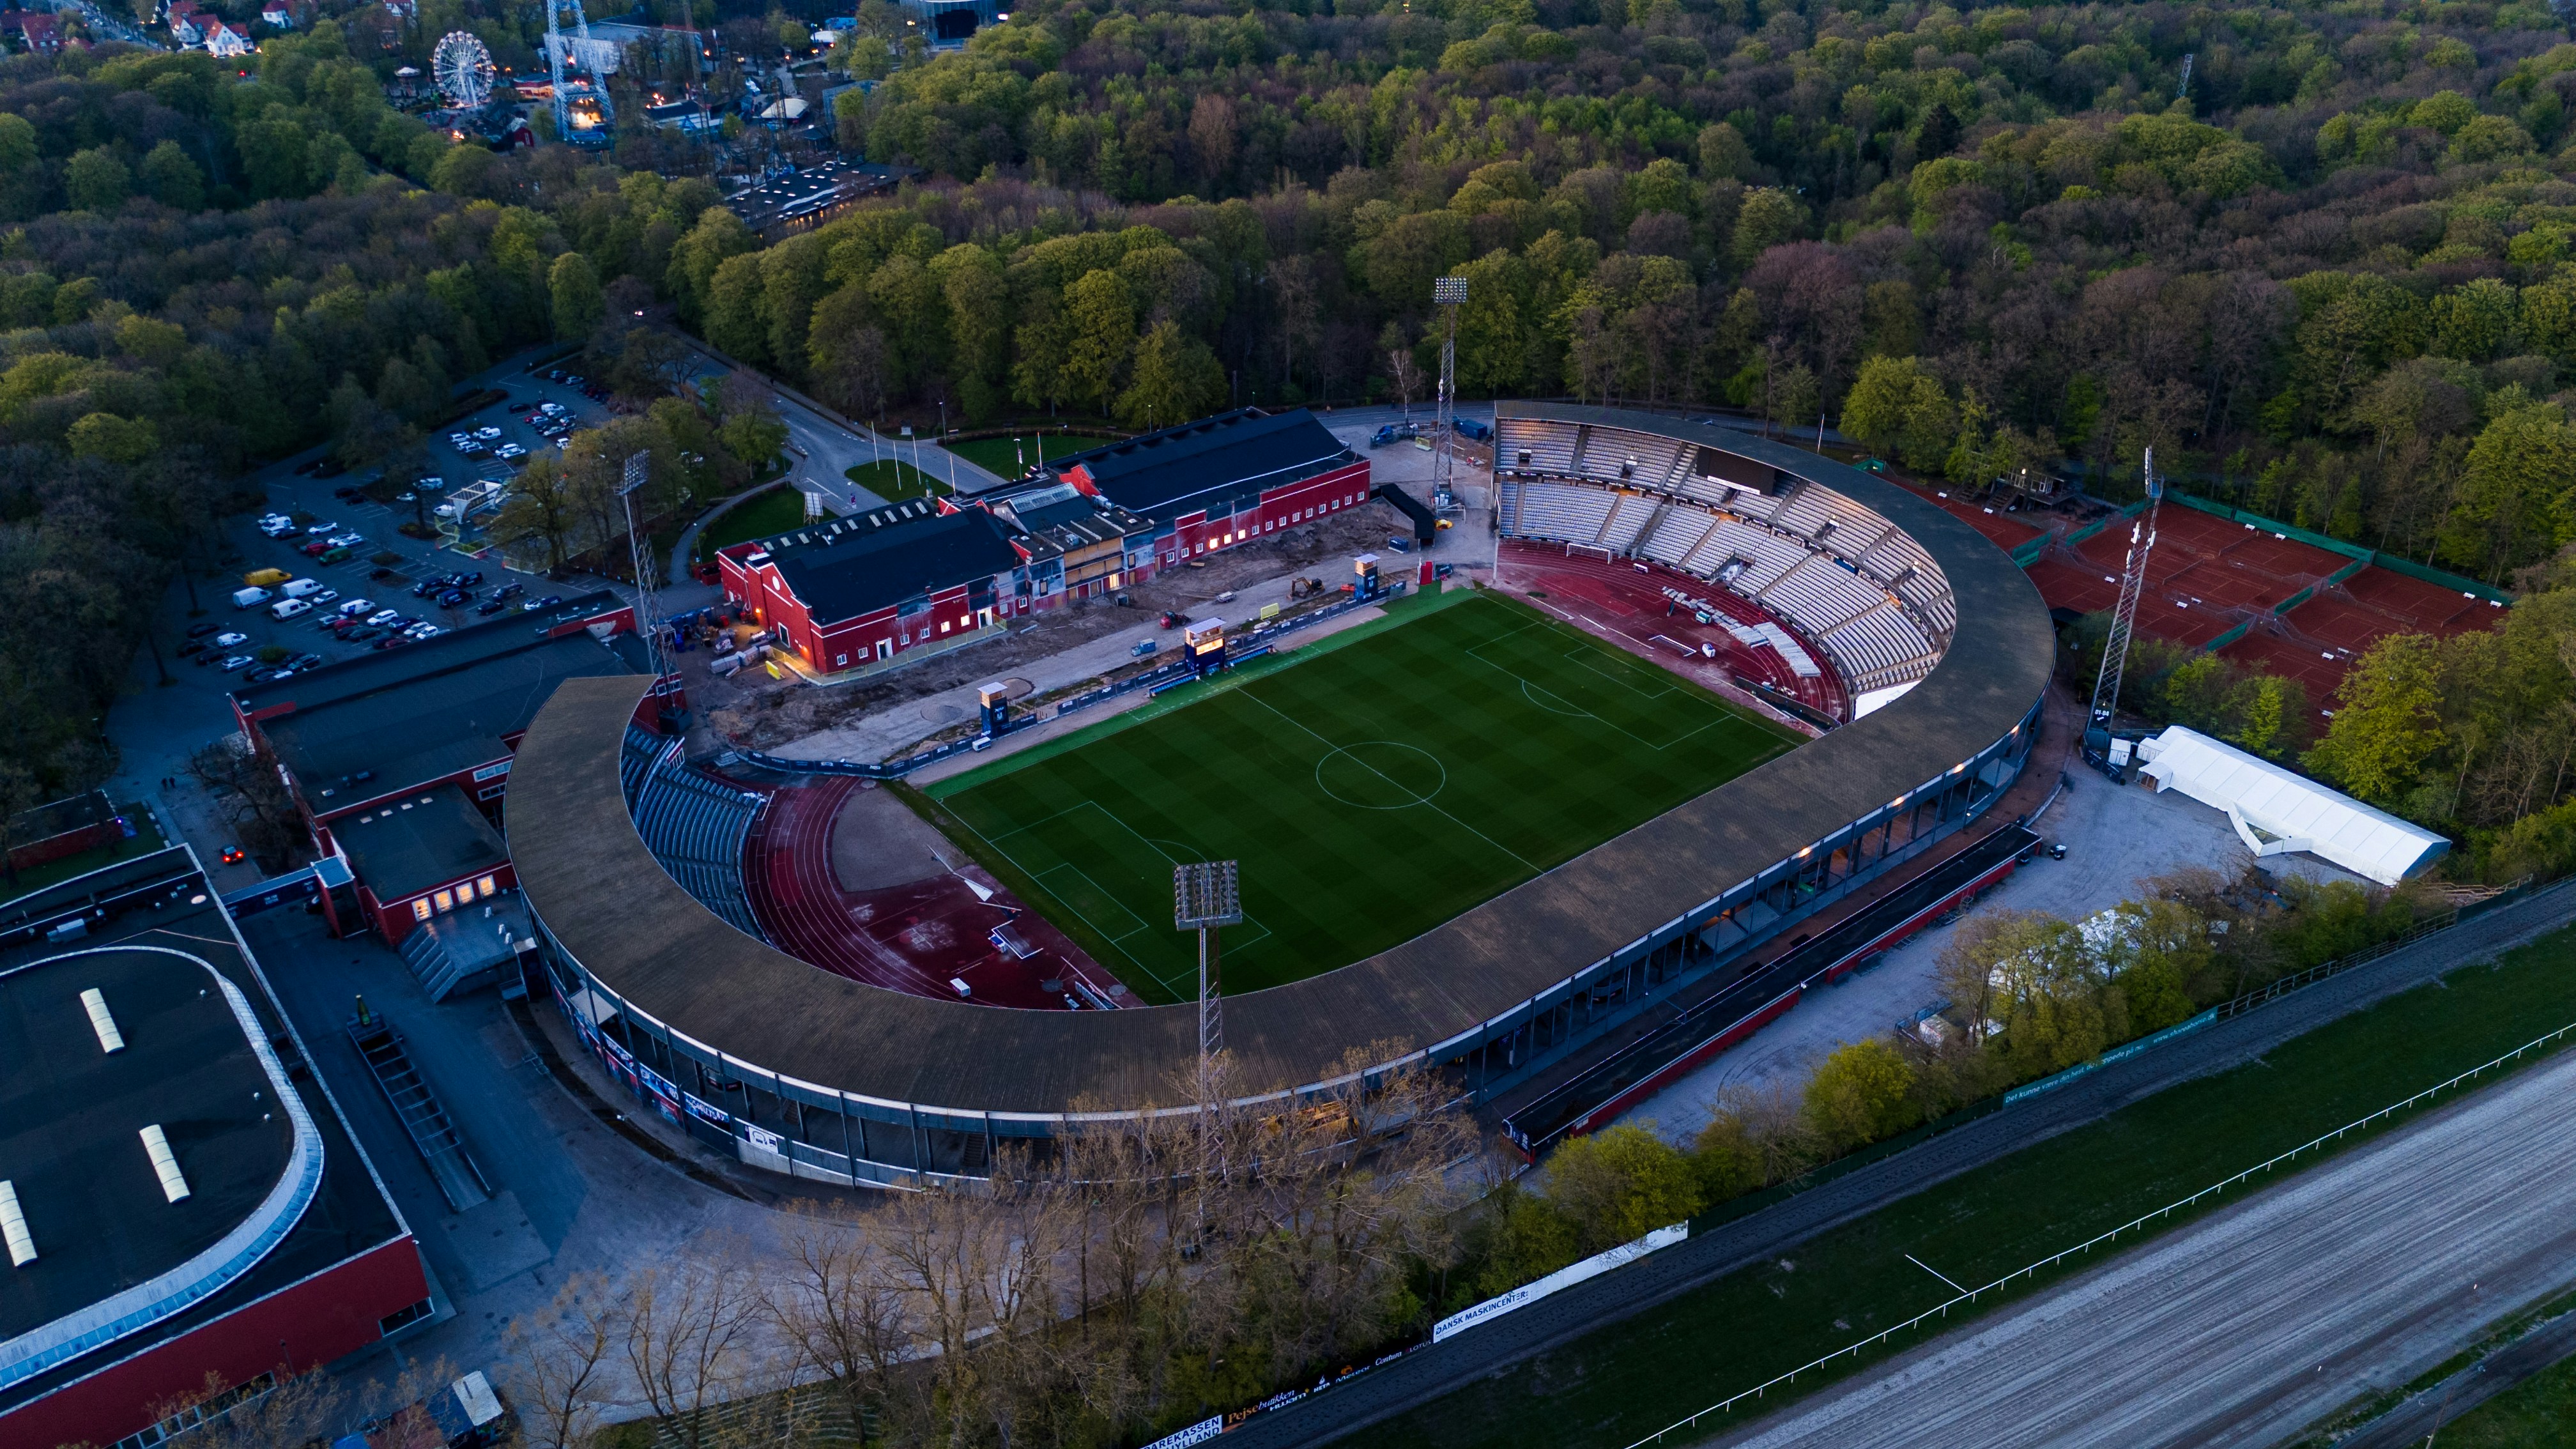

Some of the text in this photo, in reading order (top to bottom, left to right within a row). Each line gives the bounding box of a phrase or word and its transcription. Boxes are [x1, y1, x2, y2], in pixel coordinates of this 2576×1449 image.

[2005, 1092, 2018, 1103] Det
[2019, 1085, 2041, 1098] kunne
[1436, 1291, 1526, 1335] DANSK MASKINCENTER
[1409, 1339, 1431, 1353] LOTUS
[1375, 1351, 1402, 1366] Contura
